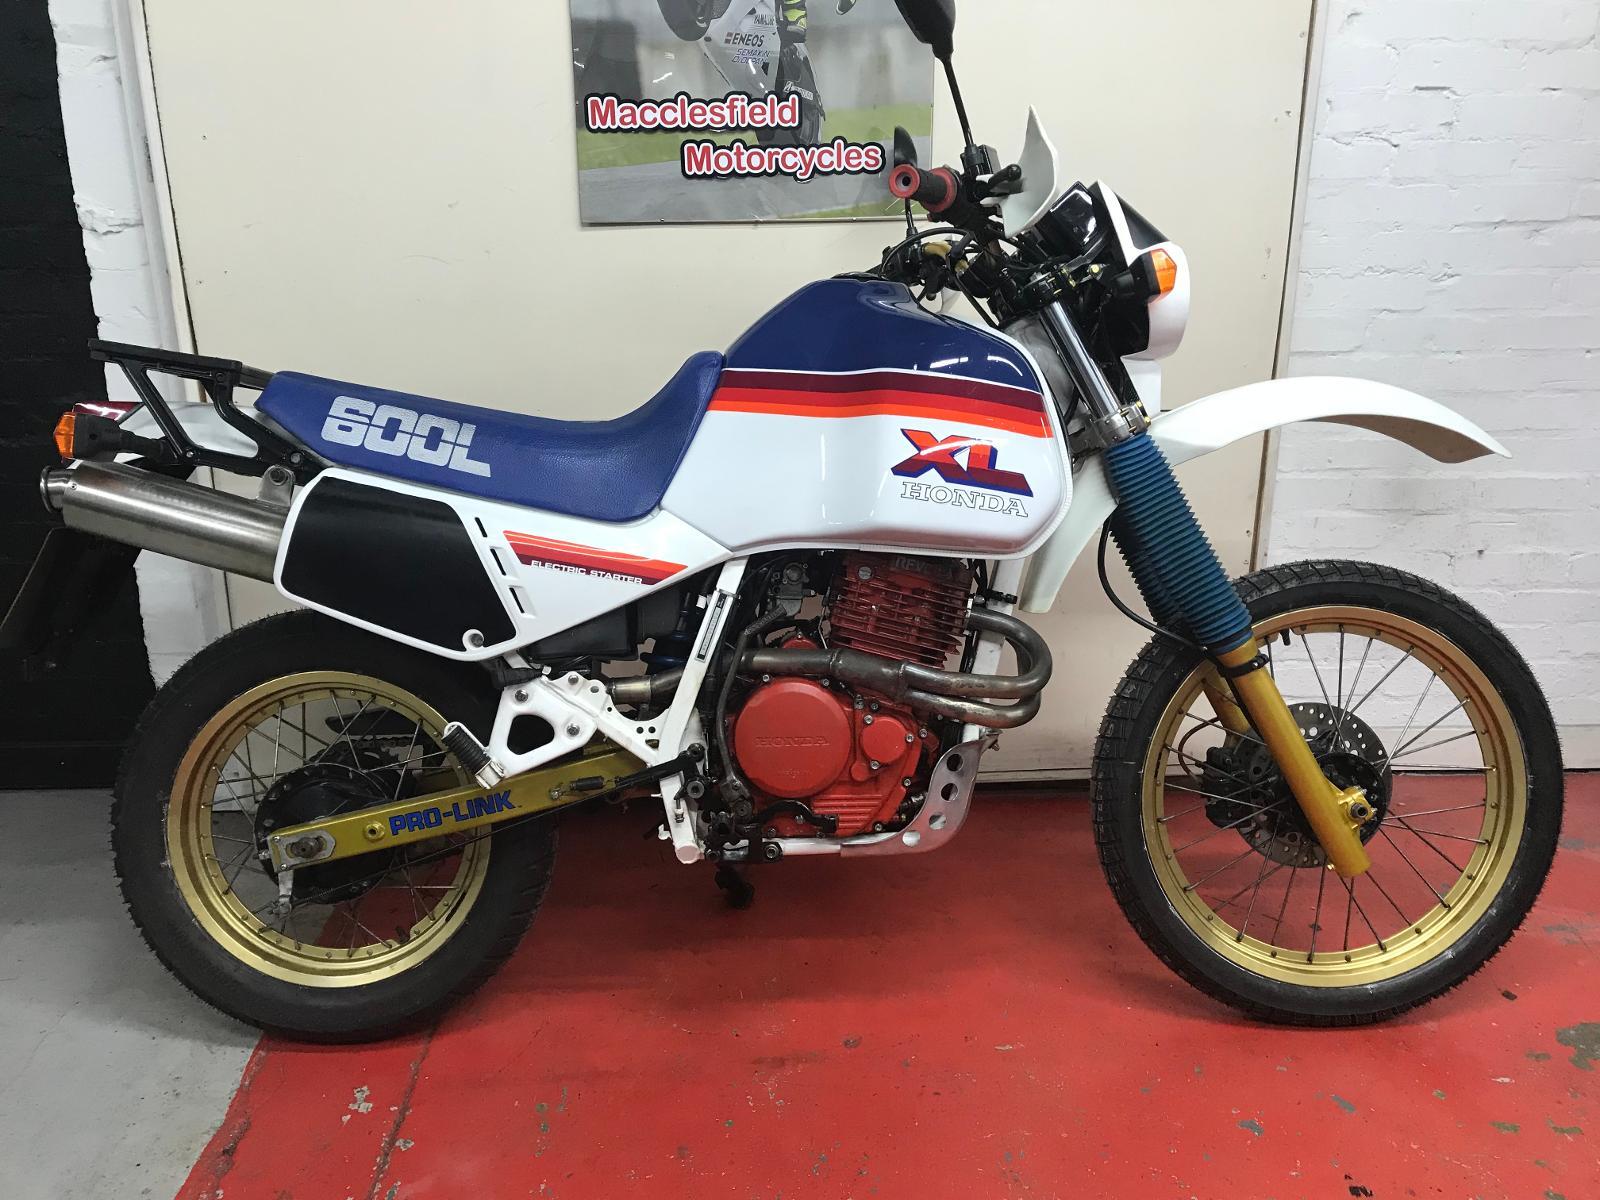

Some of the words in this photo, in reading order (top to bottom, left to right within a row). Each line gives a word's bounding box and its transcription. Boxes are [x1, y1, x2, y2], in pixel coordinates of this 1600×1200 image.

[732, 33, 764, 47] ENEOS
[587, 96, 799, 128] Macclesfield
[685, 141, 882, 178] Motorcycles
[321, 395, 491, 478] 600L
[890, 428, 1033, 498] XL
[900, 481, 1029, 517] HONDA
[530, 559, 587, 576] ELECTRIC
[590, 569, 643, 585] STARTER
[754, 736, 831, 748] HONDA
[389, 790, 516, 836] PRO-LINK
